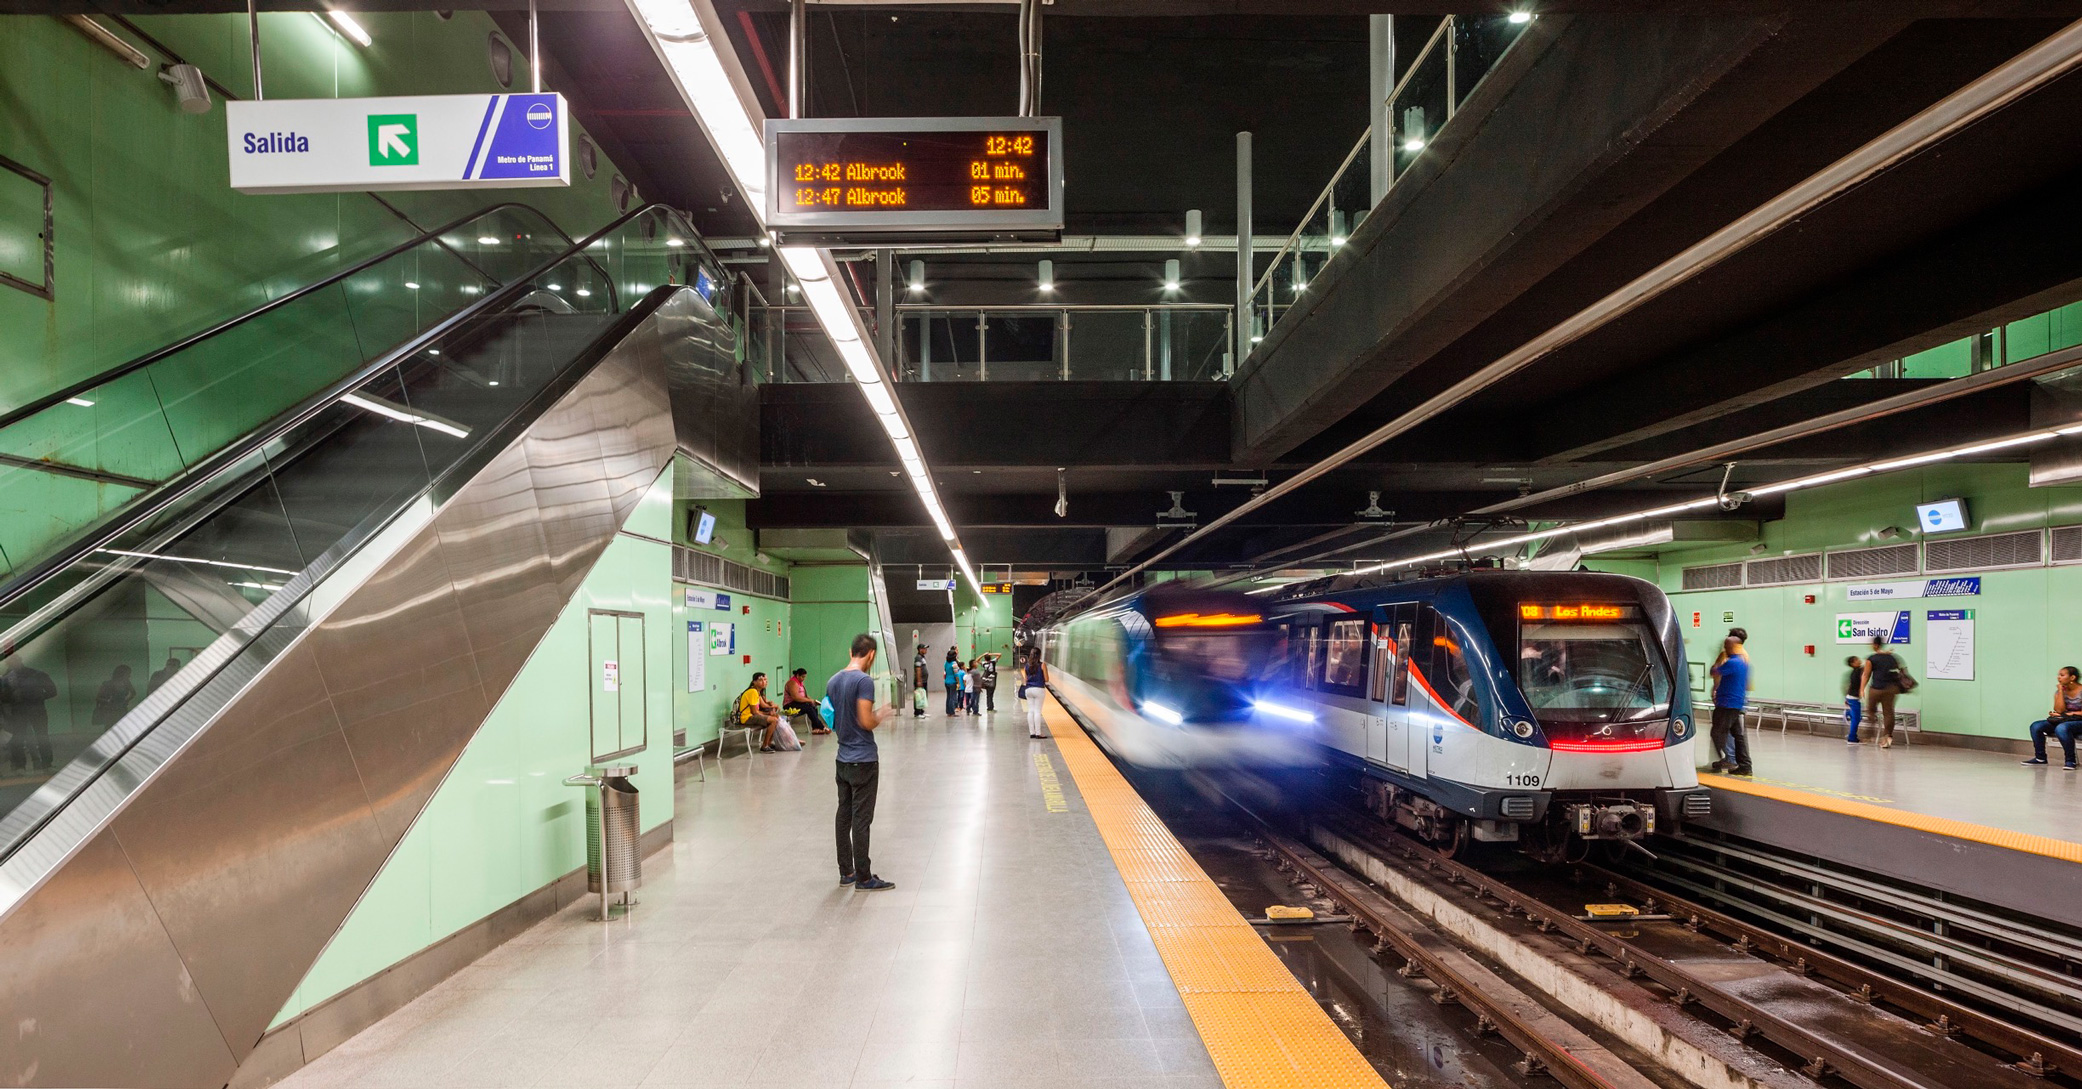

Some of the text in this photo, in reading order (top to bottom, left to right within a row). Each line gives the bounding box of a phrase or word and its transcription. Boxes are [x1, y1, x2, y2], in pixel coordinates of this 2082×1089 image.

[244, 132, 309, 154] Salida
[986, 136, 1033, 155] 12:42
[497, 156, 517, 164] Metro
[527, 154, 554, 163] Panamá
[549, 163, 554, 171] 1
[794, 163, 906, 181] 12:42 Albrook
[971, 162, 1026, 179] 01 min.
[795, 188, 906, 206] 12:47 Albrook
[971, 187, 1026, 204] 05 min.
[1880, 588, 1894, 596] Mayo
[1555, 605, 1578, 617] Los
[1581, 605, 1619, 617] Andes
[1852, 627, 1889, 637] San Isidro
[1506, 774, 1540, 787] 1109
